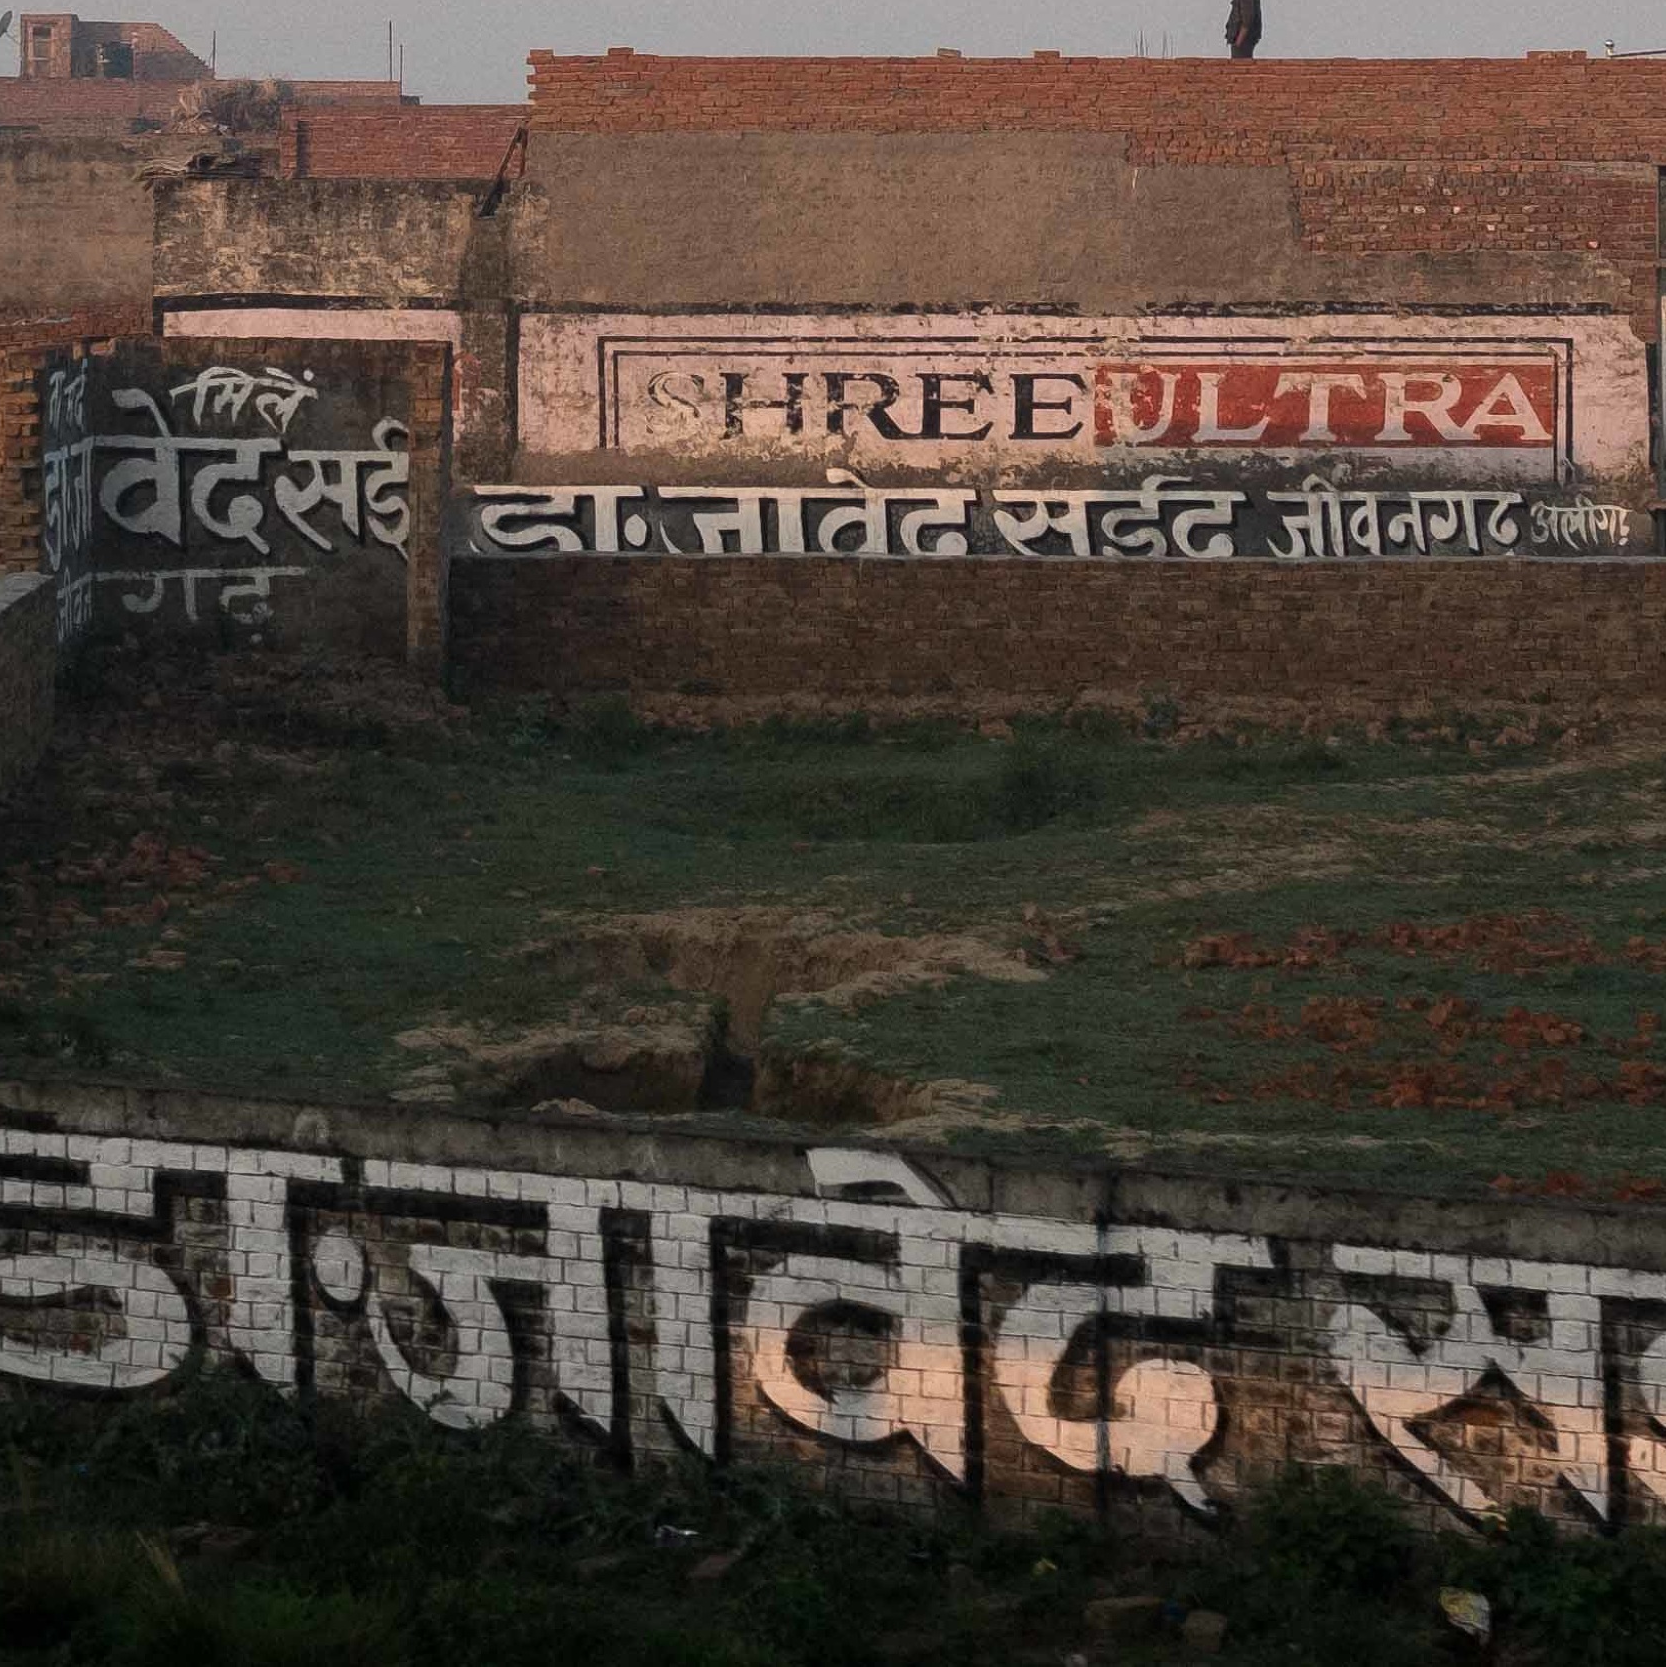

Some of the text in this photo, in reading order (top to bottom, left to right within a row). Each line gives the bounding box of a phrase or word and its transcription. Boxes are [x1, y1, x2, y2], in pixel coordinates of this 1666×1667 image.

[646, 370, 1553, 442] SHREE ULTRA
[992, 474, 1247, 559] सईद
[363, 1147, 1275, 1518] जावेद
